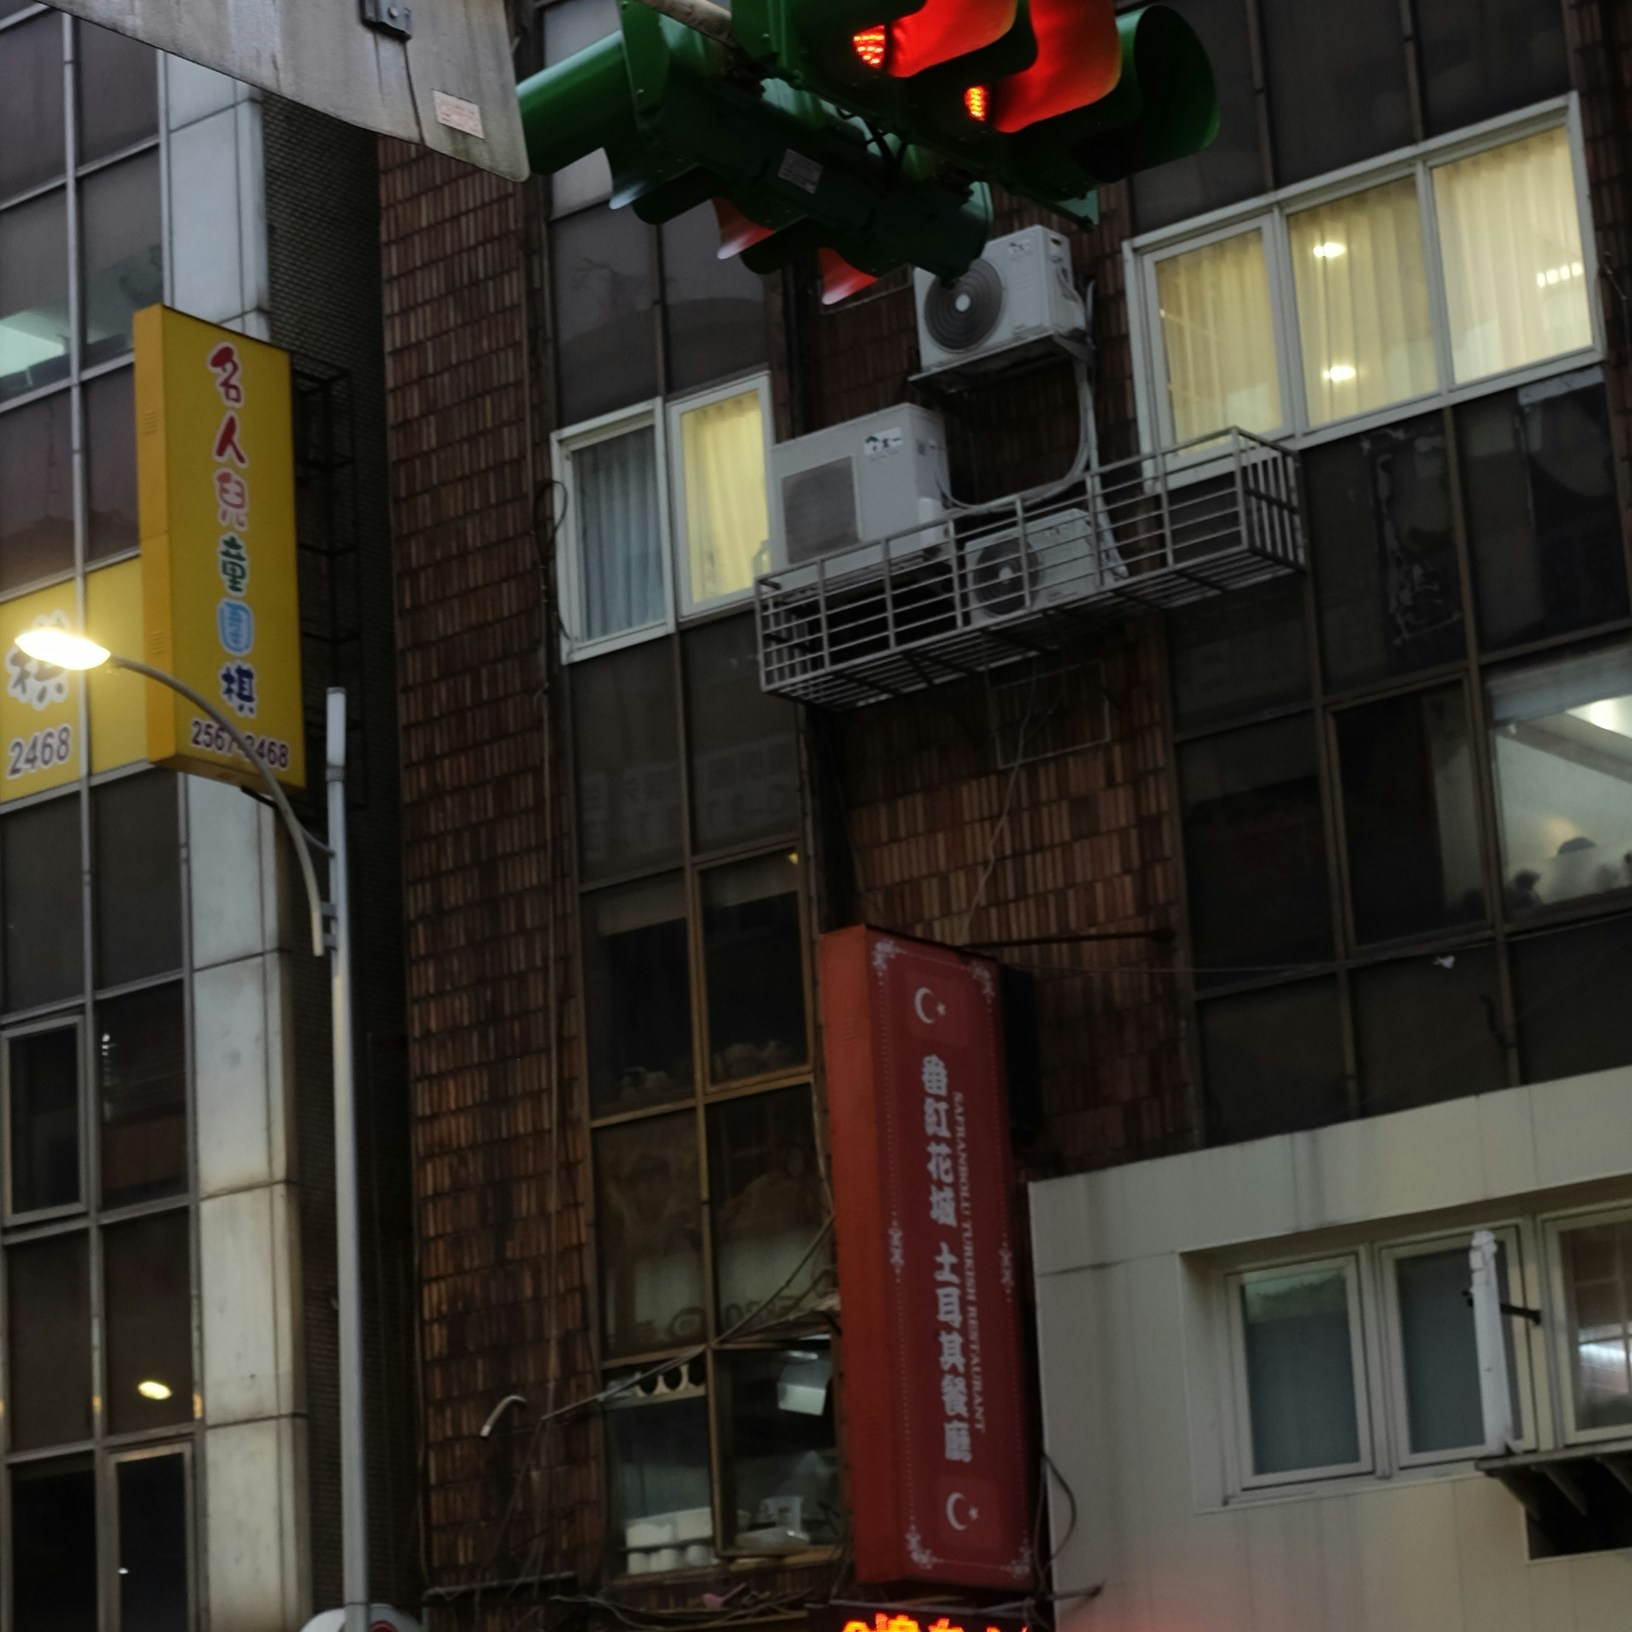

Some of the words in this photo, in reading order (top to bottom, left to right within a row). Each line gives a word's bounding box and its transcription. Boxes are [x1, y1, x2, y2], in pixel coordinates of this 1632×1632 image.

[206, 342, 258, 718] 名人兒童圍棋
[7, 724, 72, 780] 2468
[190, 717, 291, 772] 25672468
[959, 1221, 978, 1303] TURKISH
[966, 1305, 986, 1434] RESTAURANT
